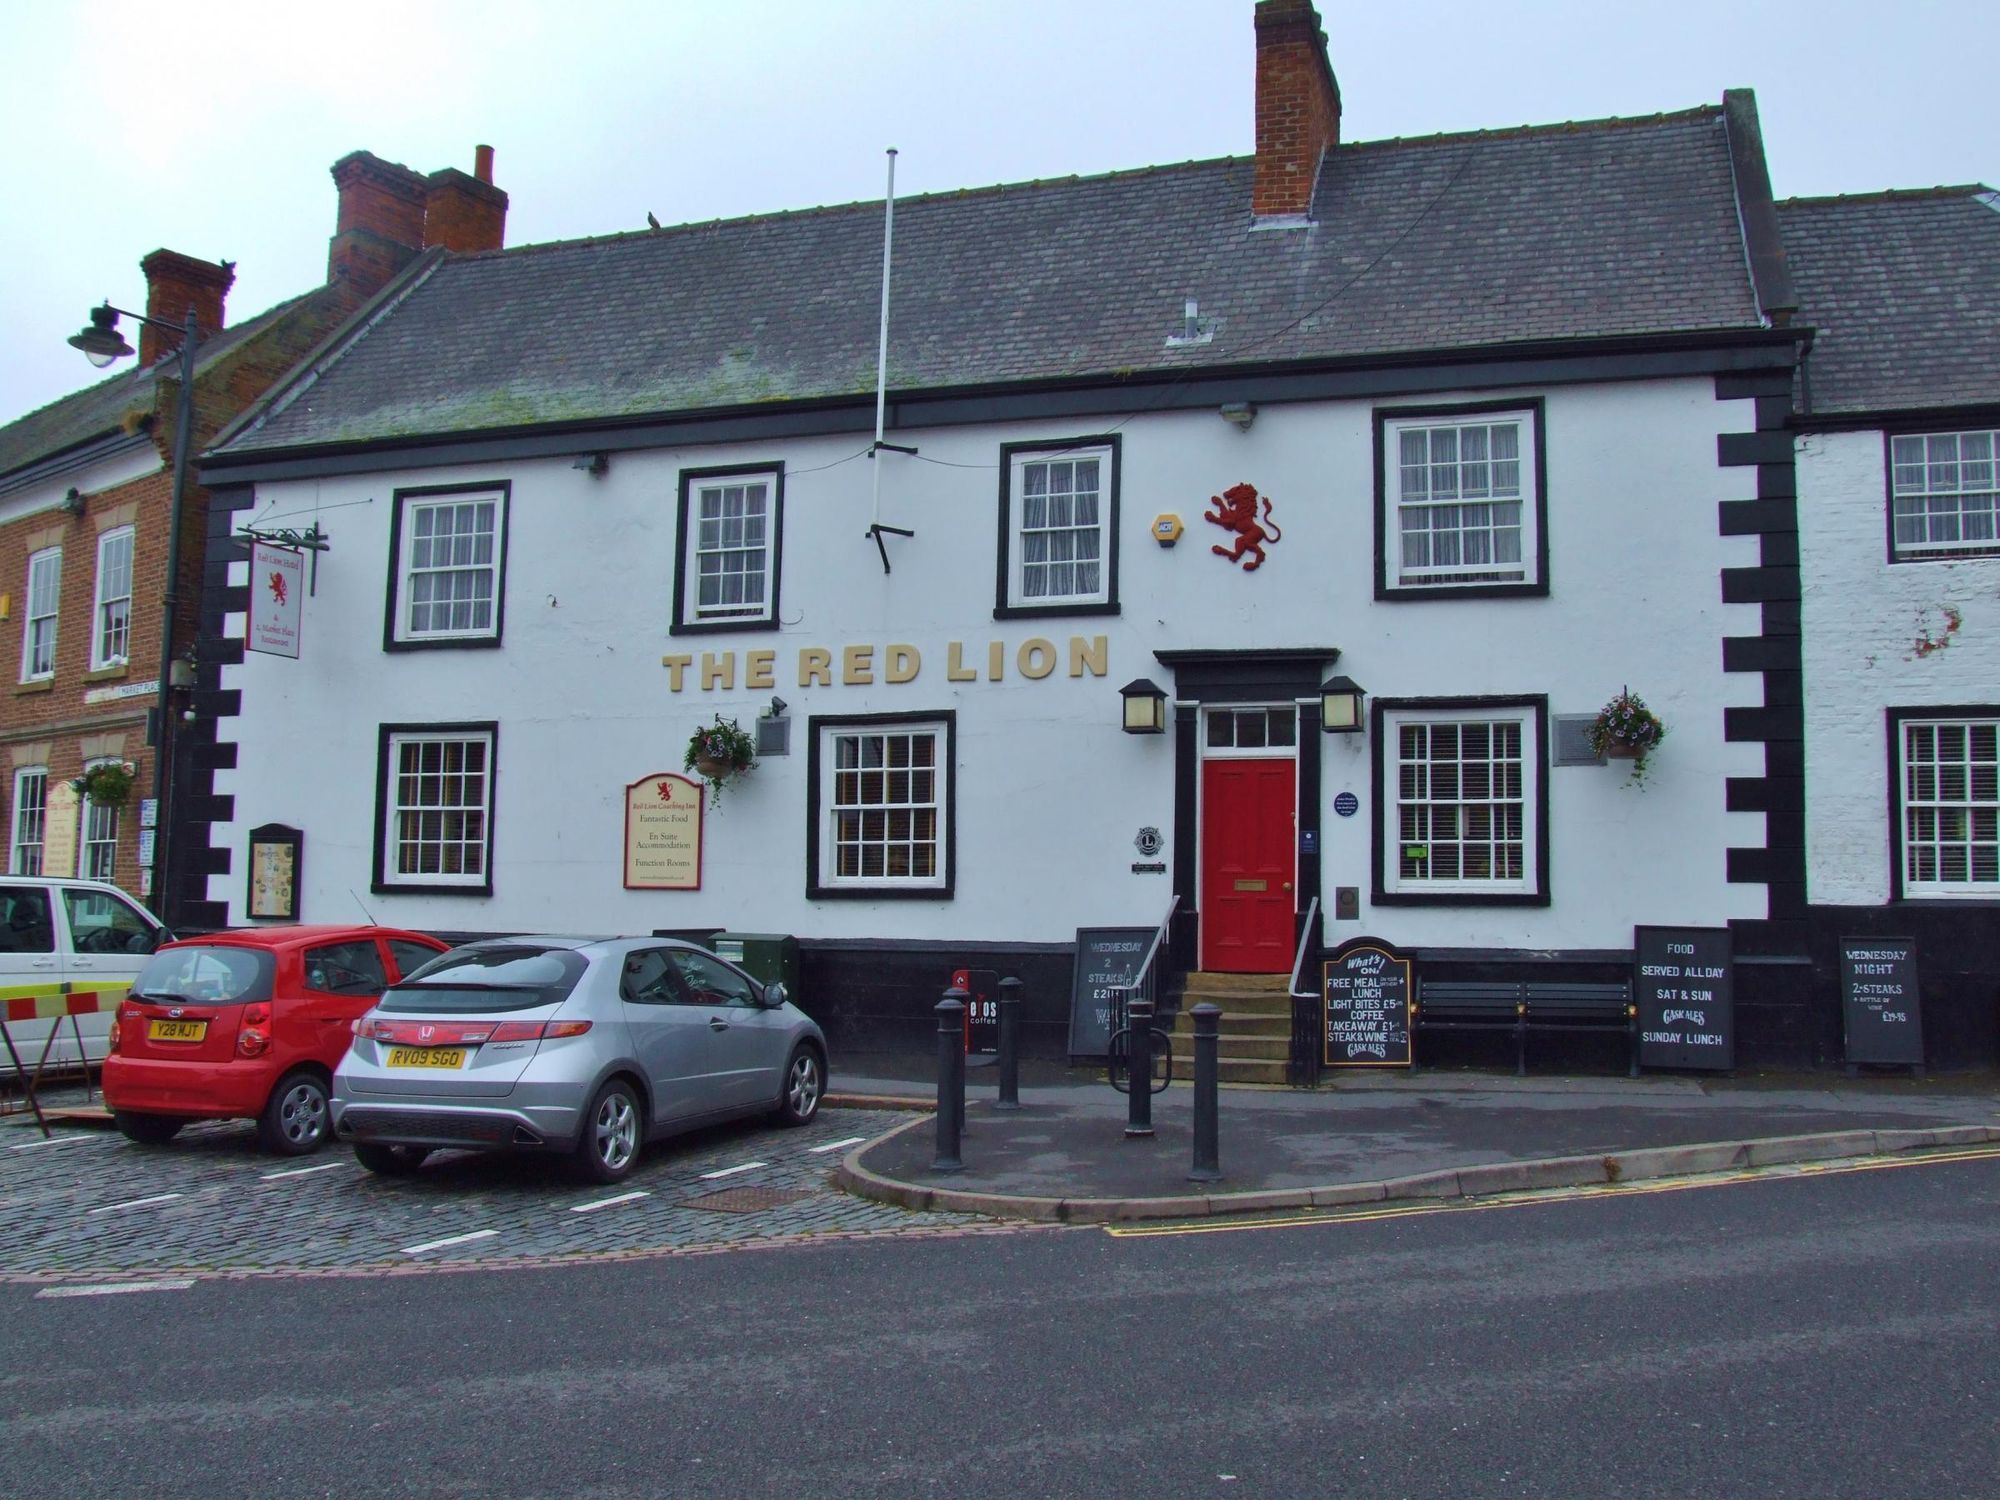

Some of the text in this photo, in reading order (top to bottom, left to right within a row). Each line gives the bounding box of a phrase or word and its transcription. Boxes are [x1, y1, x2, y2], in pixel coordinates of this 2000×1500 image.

[662, 635, 1108, 693] THE RED LION
[640, 814, 689, 823] Fantastic Food
[649, 832, 678, 841] En Suite
[636, 841, 691, 849] Accommodation
[635, 858, 690, 867] Function Rooms
[1090, 942, 1143, 953] WEDNESDAY
[1667, 943, 1694, 955] FOOD
[1846, 950, 1907, 961] WEDNESDAY
[1104, 958, 1111, 968] 2
[1347, 954, 1381, 970] What's
[1641, 966, 1680, 978] SERVED
[1854, 963, 1893, 974] NIGHT
[1088, 974, 1123, 984] STEAKS
[1327, 978, 1379, 989] FREE MEAL
[1352, 989, 1381, 999] LUNCH
[1657, 989, 1712, 1002] SAT & SUN
[1328, 1000, 1352, 1010] LIGHT
[1355, 1000, 1380, 1009] BITES
[1351, 1011, 1384, 1020] COFFEE
[1685, 1010, 1705, 1026] ALES
[158, 1023, 199, 1037] Y28 MJT
[1328, 1021, 1378, 1031] TAKEAWAY
[1642, 1031, 1722, 1046] SUNDAY LUNCH
[1367, 1043, 1386, 1058] ALES
[393, 1050, 427, 1065] RV09
